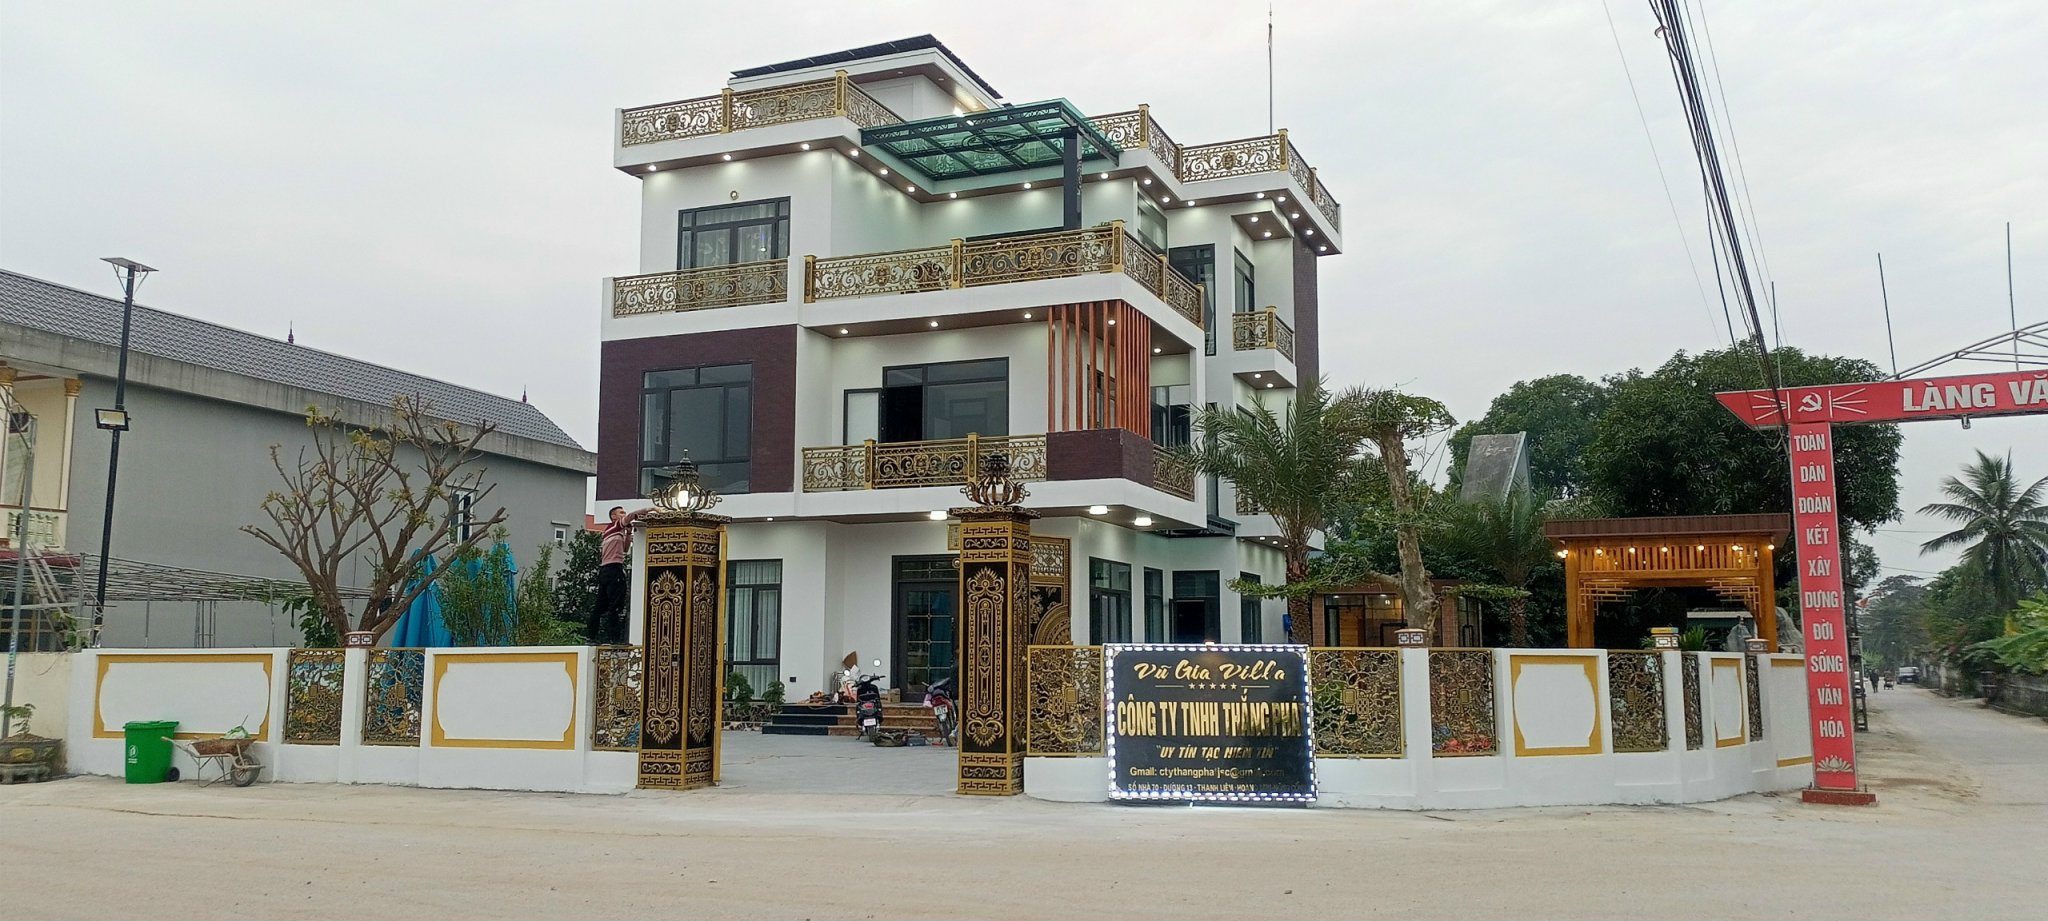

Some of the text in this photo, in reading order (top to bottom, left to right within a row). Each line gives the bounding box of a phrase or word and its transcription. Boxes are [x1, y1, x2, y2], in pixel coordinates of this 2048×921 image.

[1903, 381, 1996, 412] LÀNG
[1794, 430, 1826, 452] TOÀN
[1800, 461, 1826, 483] DÂN
[1798, 492, 1832, 514] ĐOÀN
[1806, 522, 1829, 545] KẾT
[1808, 555, 1831, 577] XÂY
[1804, 590, 1839, 612] DỰNG
[1812, 618, 1834, 640] ĐỜI
[1133, 659, 1285, 680] Vũ Gia Villa
[1810, 649, 1844, 673] SỐNG
[1817, 683, 1843, 705] VĂN
[1117, 693, 1157, 737] CÔNG
[1160, 701, 1178, 737] TY
[1181, 701, 1220, 737] TNHH
[1222, 688, 1270, 737] THẮNG
[1819, 716, 1846, 738] HÓA
[1178, 744, 1198, 759] TÍN
[1129, 766, 1158, 777] Gmail:
[1197, 783, 1219, 792] THANH
